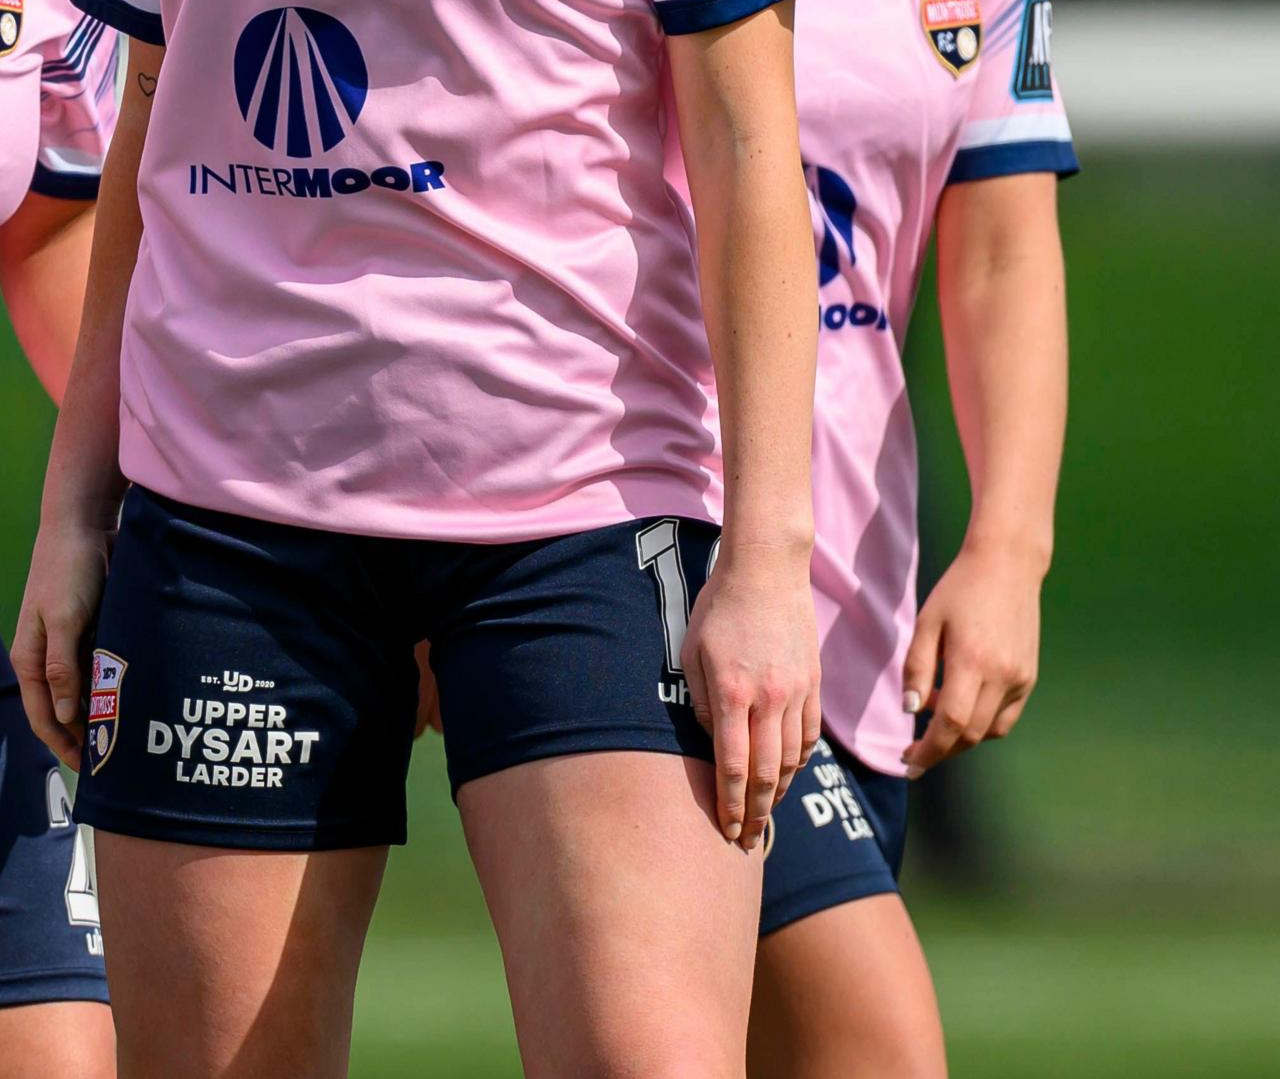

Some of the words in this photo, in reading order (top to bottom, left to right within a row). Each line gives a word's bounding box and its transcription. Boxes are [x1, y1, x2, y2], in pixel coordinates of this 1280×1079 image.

[189, 160, 446, 199] INTERMOOR
[201, 675, 221, 685] EST.
[223, 670, 253, 692] UD
[255, 680, 275, 689] 2020
[182, 698, 287, 729] UPPER
[147, 720, 320, 764] DYSART
[176, 761, 283, 788] LARDER
[802, 786, 864, 828] DYS
